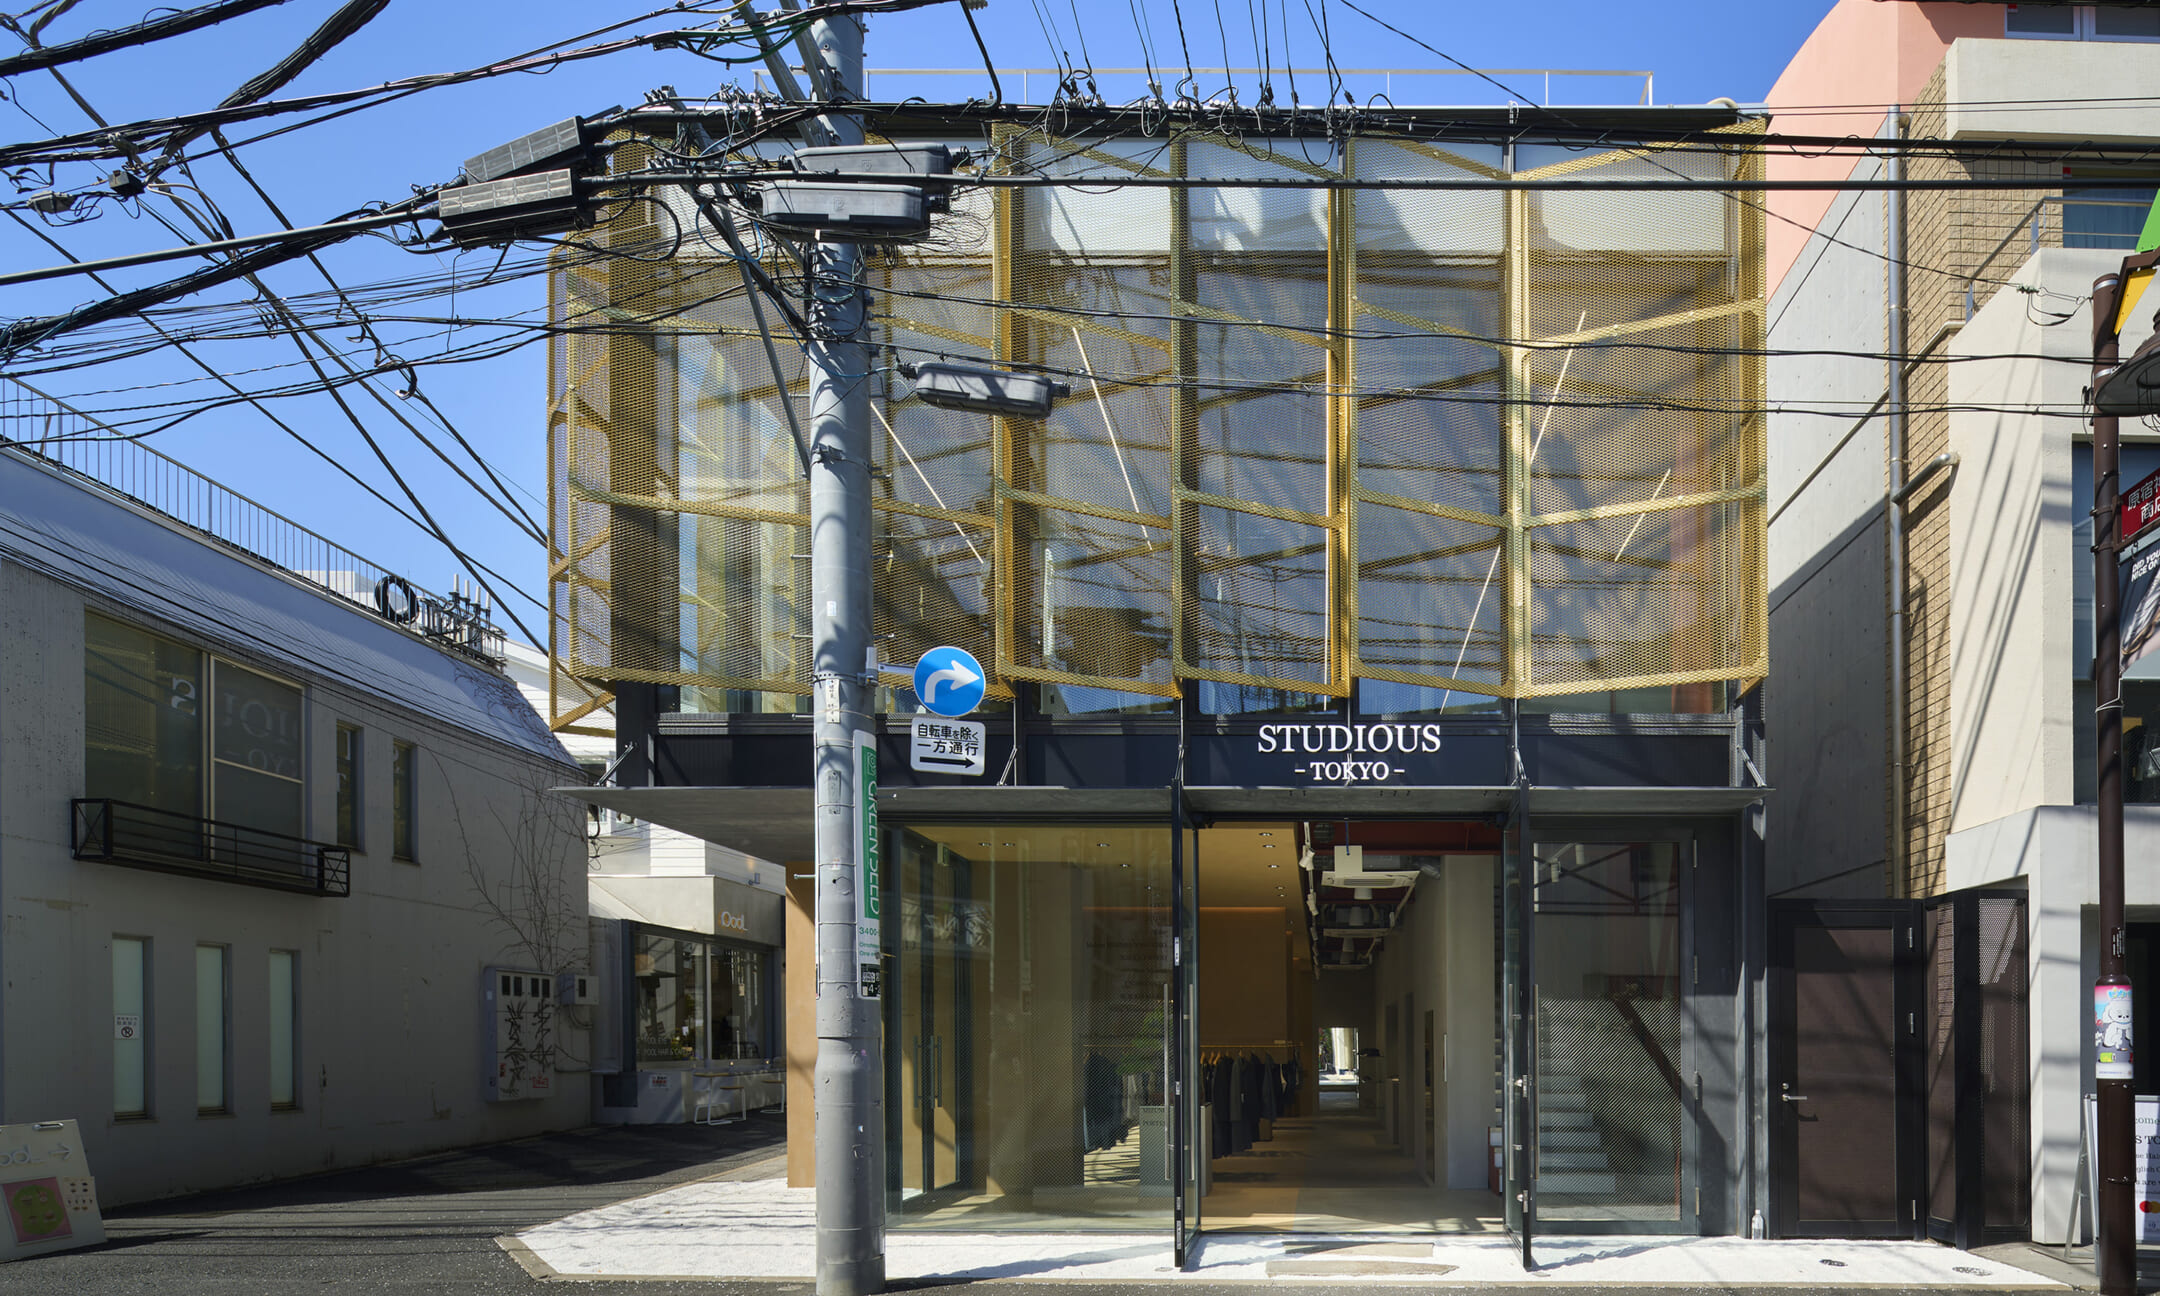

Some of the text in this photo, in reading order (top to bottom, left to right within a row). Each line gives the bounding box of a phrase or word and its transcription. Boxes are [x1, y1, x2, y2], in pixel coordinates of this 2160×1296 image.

[918, 724, 979, 741] 自転車を除く
[1258, 724, 1441, 753] STUDIOUS
[917, 739, 979, 756] 一方通行
